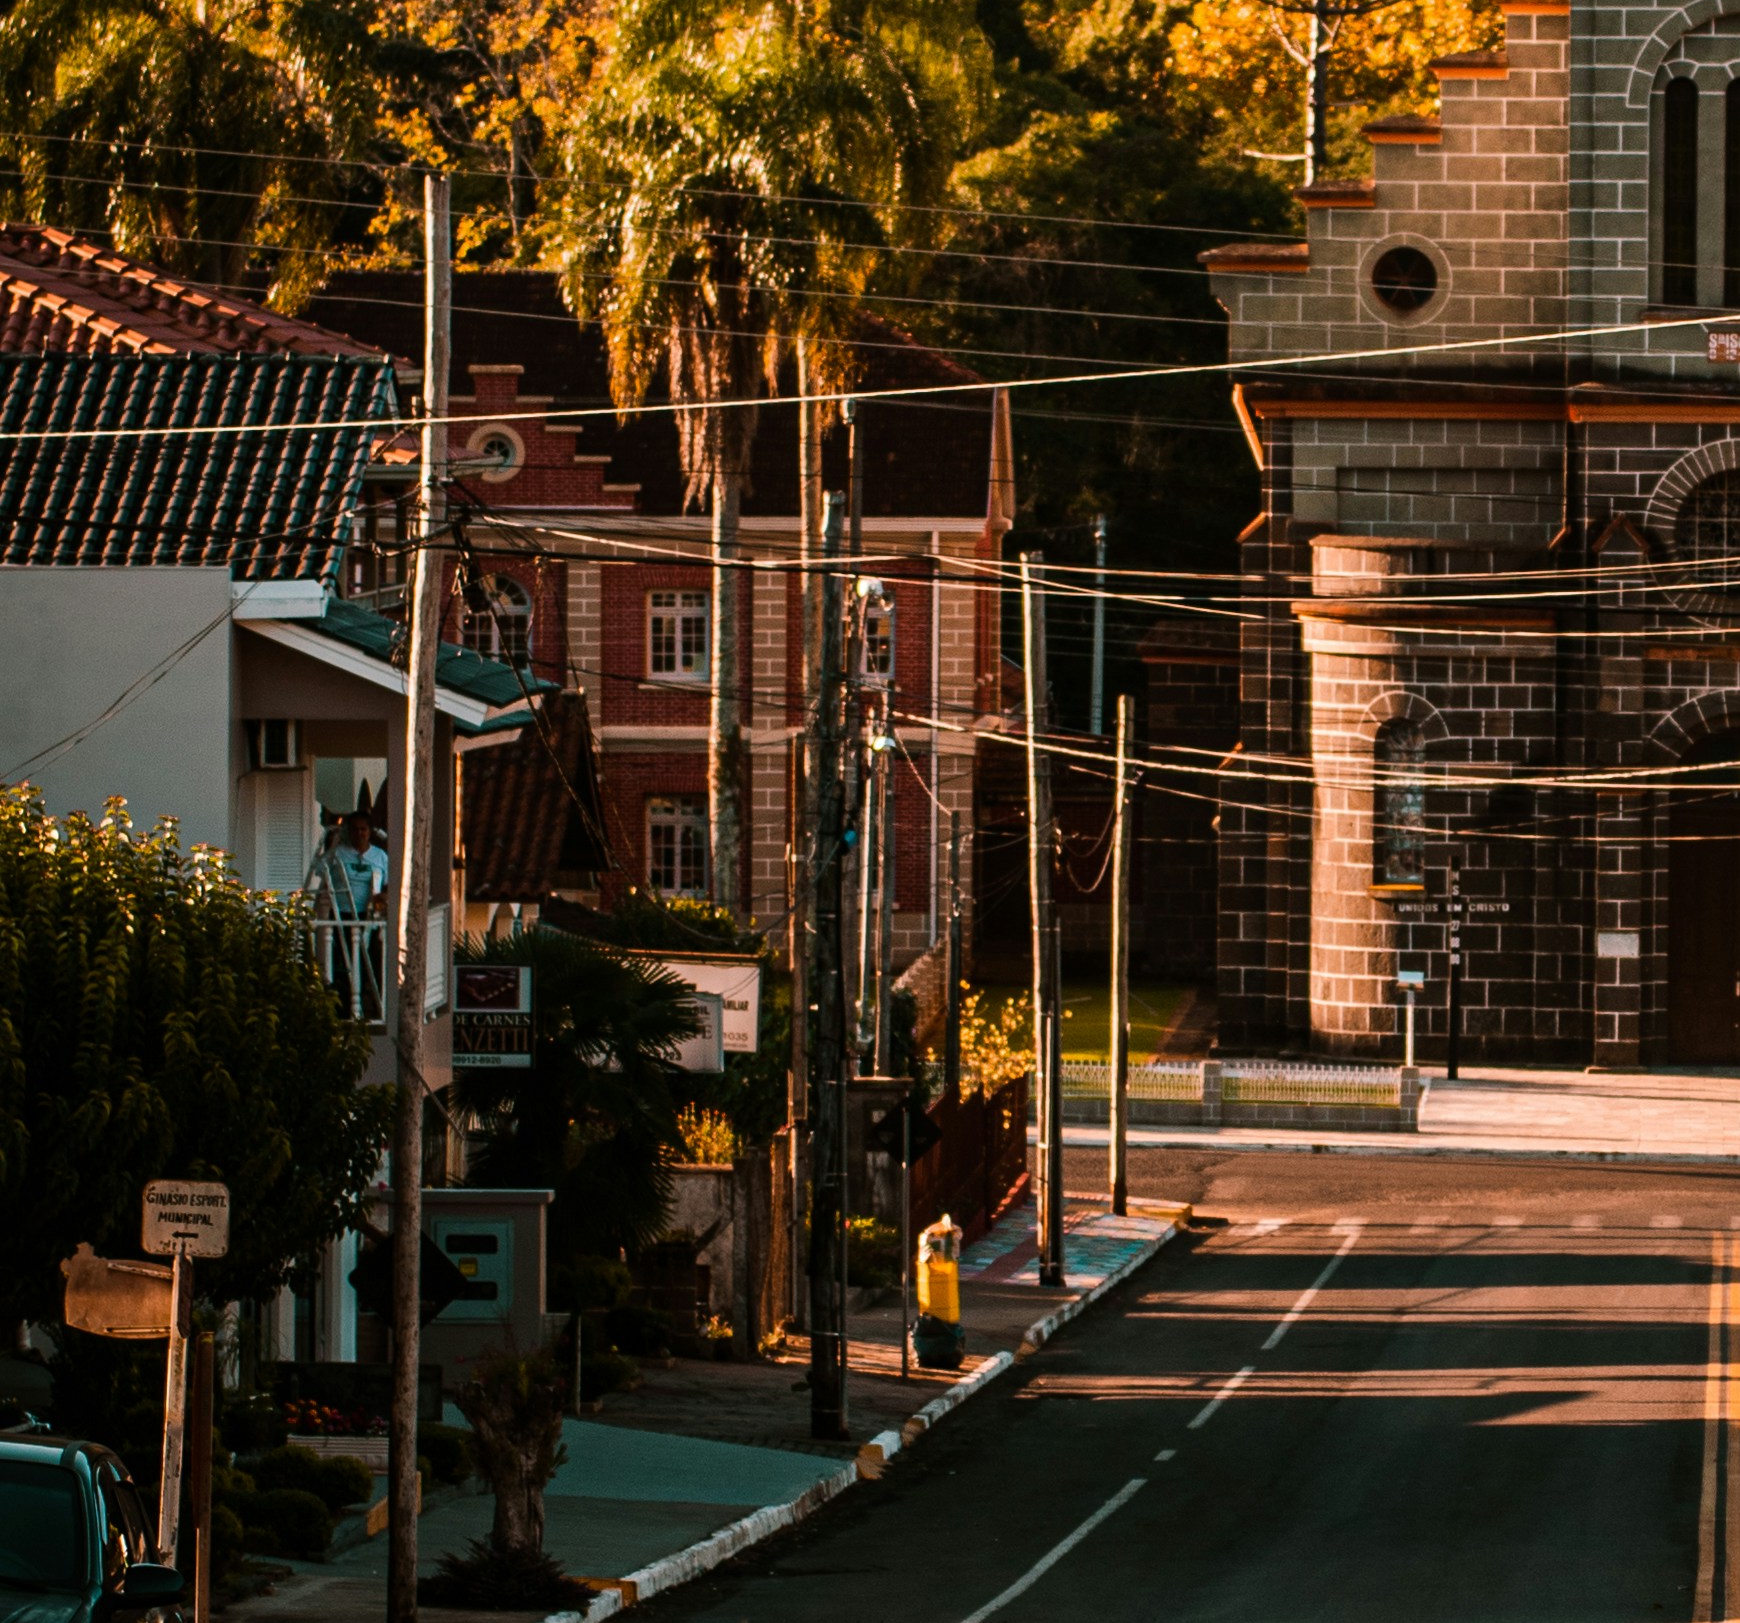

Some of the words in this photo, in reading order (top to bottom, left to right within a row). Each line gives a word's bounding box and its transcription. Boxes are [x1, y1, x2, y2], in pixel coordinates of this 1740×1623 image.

[1398, 904, 1438, 912] UNIDOS
[1446, 904, 1462, 912] EM
[1468, 904, 1510, 912] CRISTO
[472, 1015, 531, 1026] CARNES
[158, 1212, 214, 1226] MUNICIPAL
